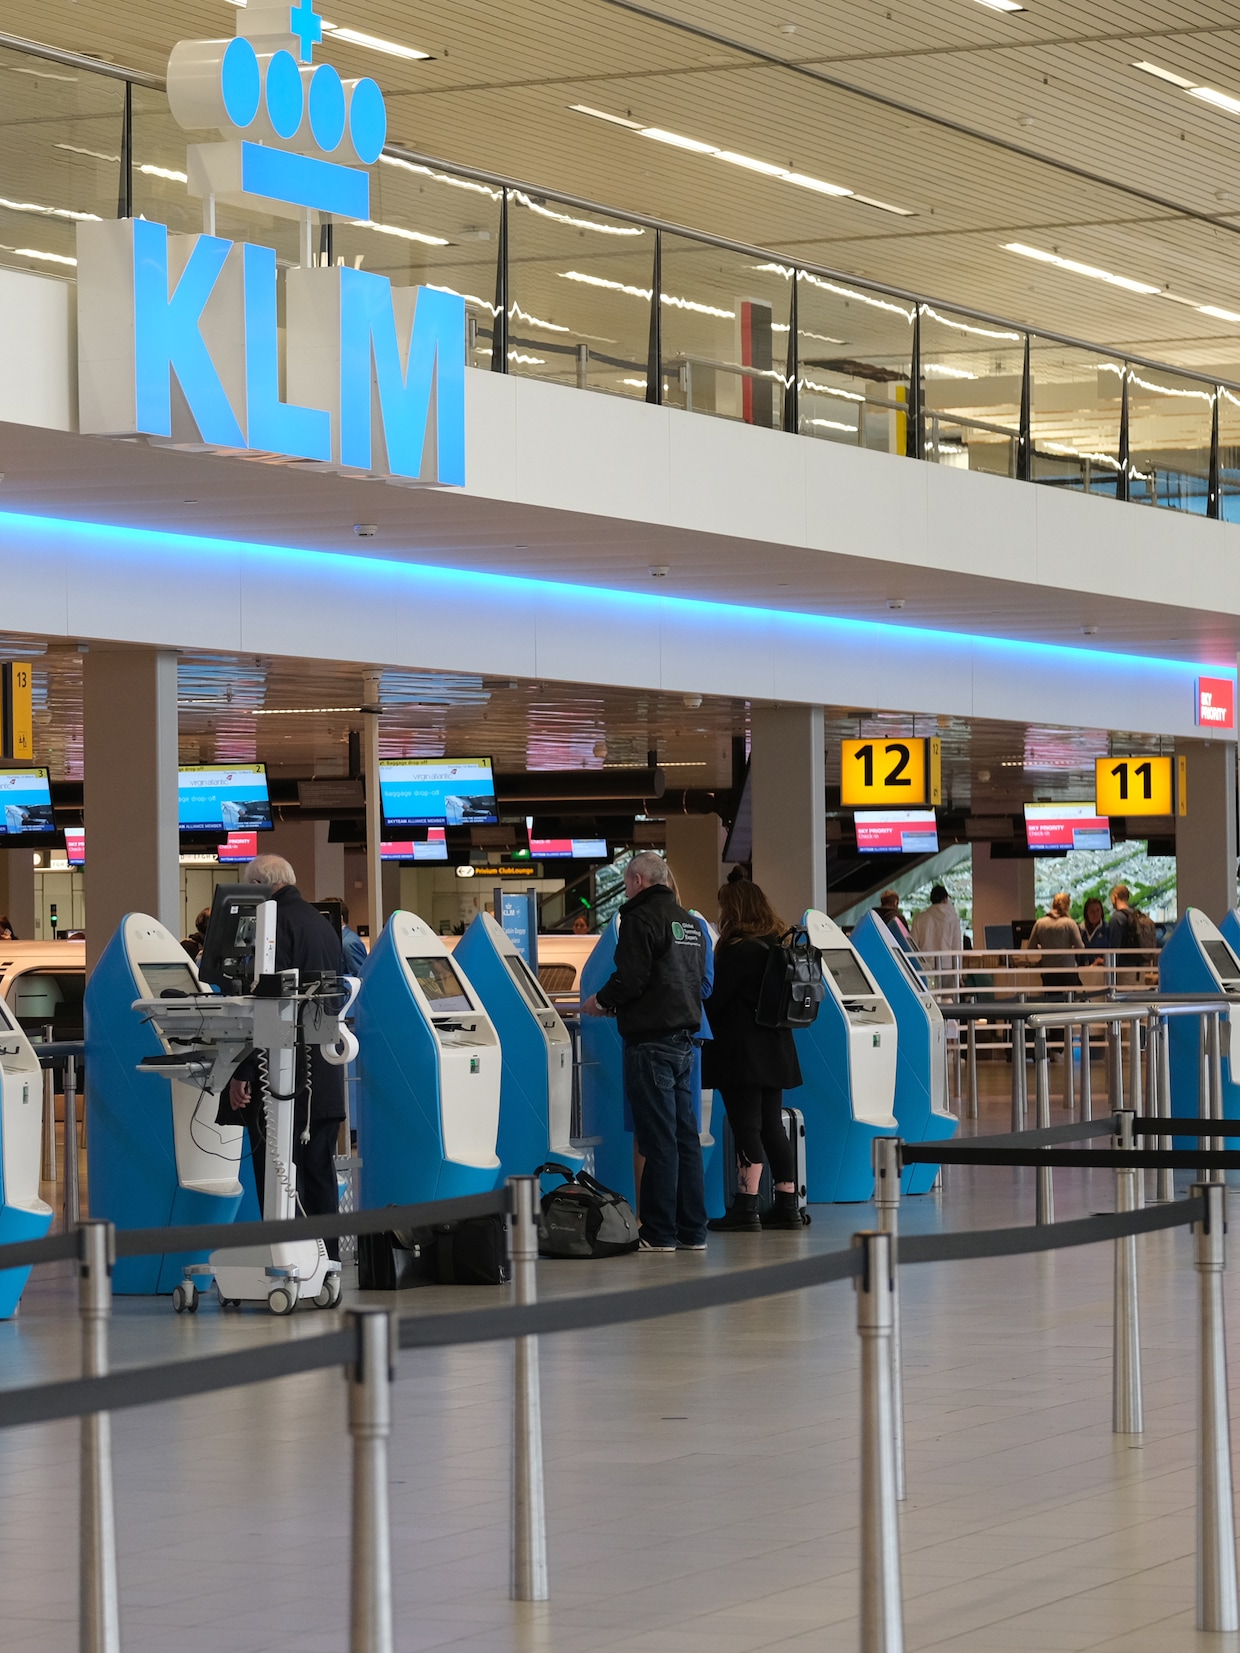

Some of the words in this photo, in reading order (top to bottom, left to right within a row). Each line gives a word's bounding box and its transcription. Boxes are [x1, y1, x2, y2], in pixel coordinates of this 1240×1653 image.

[133, 217, 465, 487] KLM
[17, 672, 27, 688] 13
[932, 743, 939, 756] 12
[255, 765, 261, 773] 2
[854, 743, 912, 786] 12
[38, 769, 44, 777] 3
[1110, 762, 1152, 799] 11
